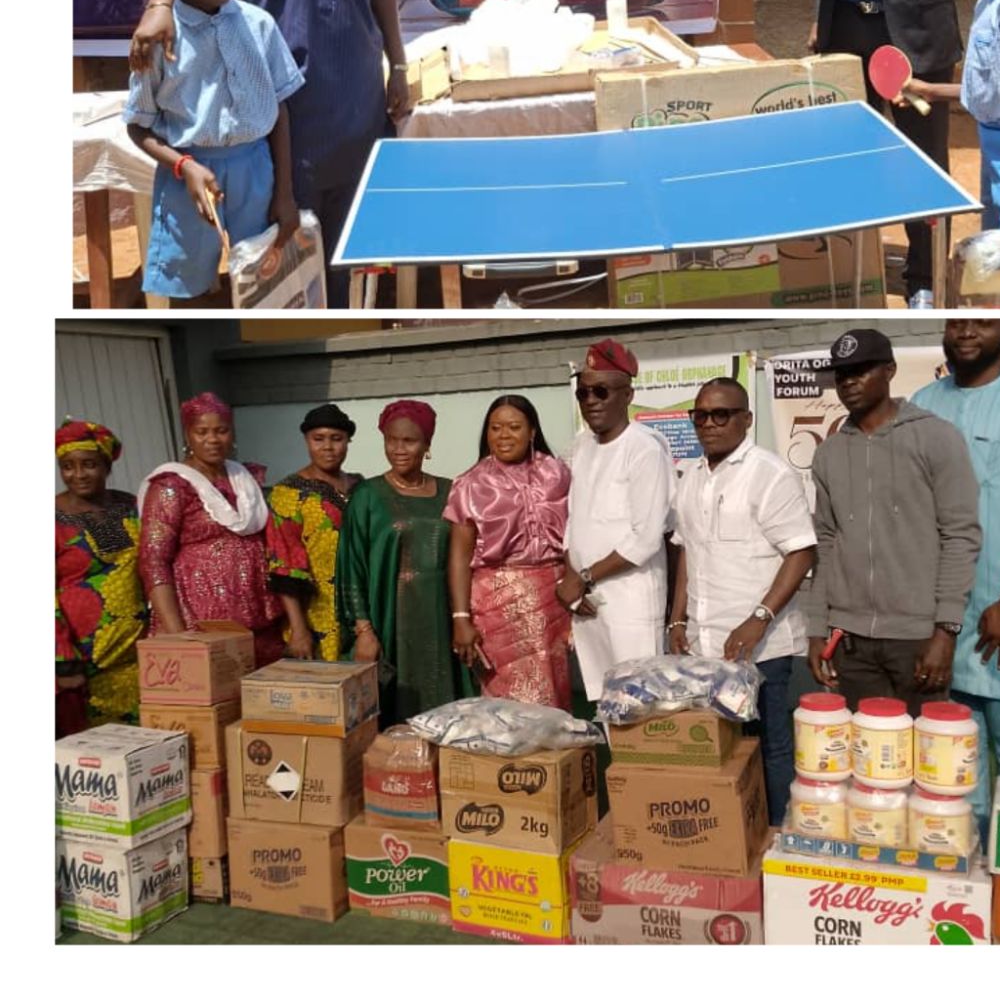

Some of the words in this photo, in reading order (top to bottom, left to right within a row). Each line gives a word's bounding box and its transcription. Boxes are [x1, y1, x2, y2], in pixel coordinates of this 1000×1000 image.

[667, 100, 713, 113] SPORT
[755, 97, 804, 114] world's
[774, 372, 816, 383] YOUTH
[776, 386, 820, 397] FORUM
[55, 764, 118, 799] Mama
[501, 771, 541, 787] MILO
[137, 770, 184, 807] Mama
[650, 797, 710, 818] PROMO
[462, 812, 500, 827] MILO
[520, 816, 549, 838] 2kg
[253, 847, 302, 862] PROMO
[56, 856, 119, 898] Mama
[785, 864, 809, 874] BEST
[811, 867, 848, 880] SELLER
[138, 863, 182, 903] Mama
[389, 881, 407, 892] Oil
[622, 870, 704, 905] Kellogg's
[808, 882, 925, 927] Kellogg's
[640, 906, 681, 926] CORN
[641, 924, 682, 940] FLAKES
[814, 916, 862, 938] CORN
